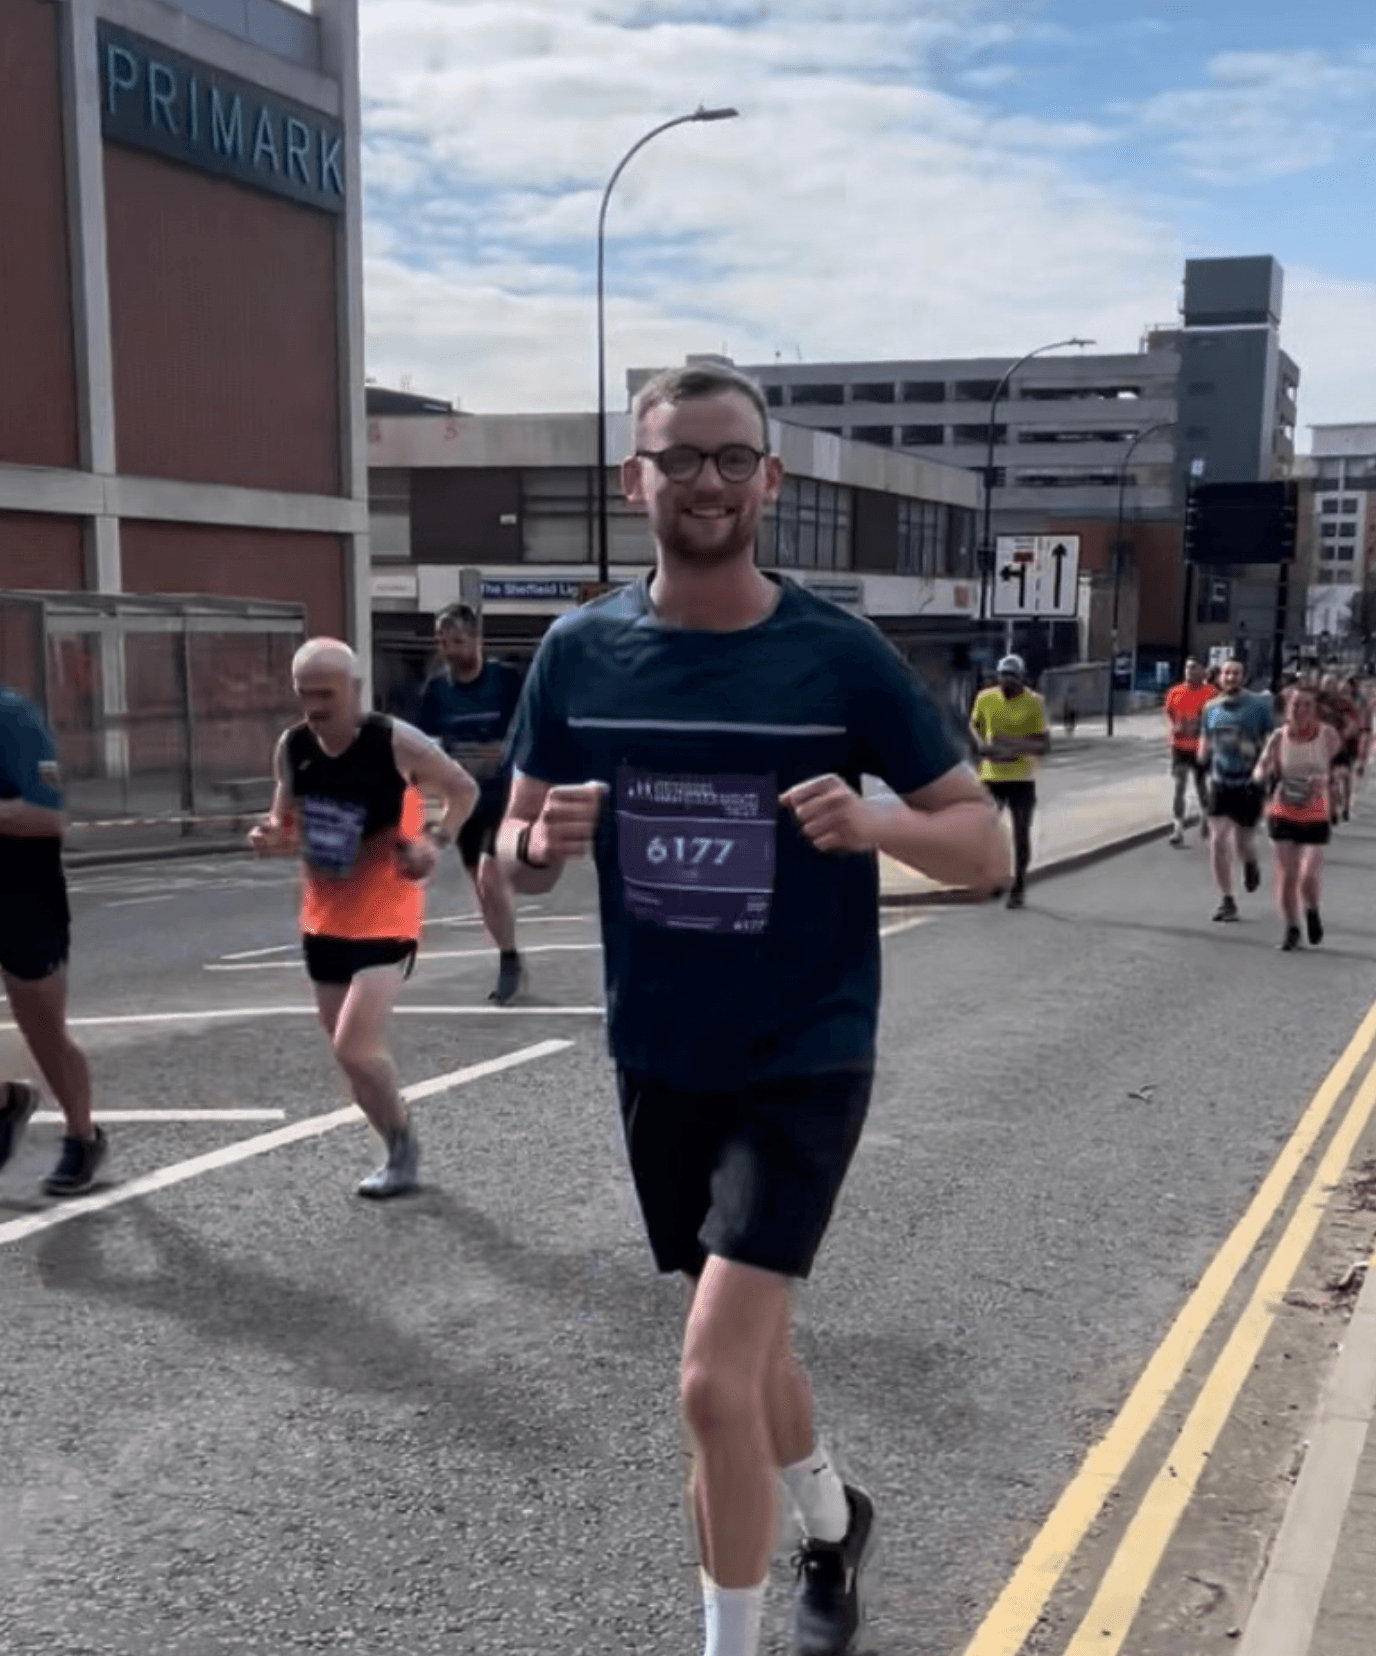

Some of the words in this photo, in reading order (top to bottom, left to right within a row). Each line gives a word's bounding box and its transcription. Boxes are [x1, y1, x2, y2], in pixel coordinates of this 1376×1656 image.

[107, 43, 345, 196] PRIMARK
[504, 582, 557, 595] Sheffield
[646, 836, 735, 865] 6177
